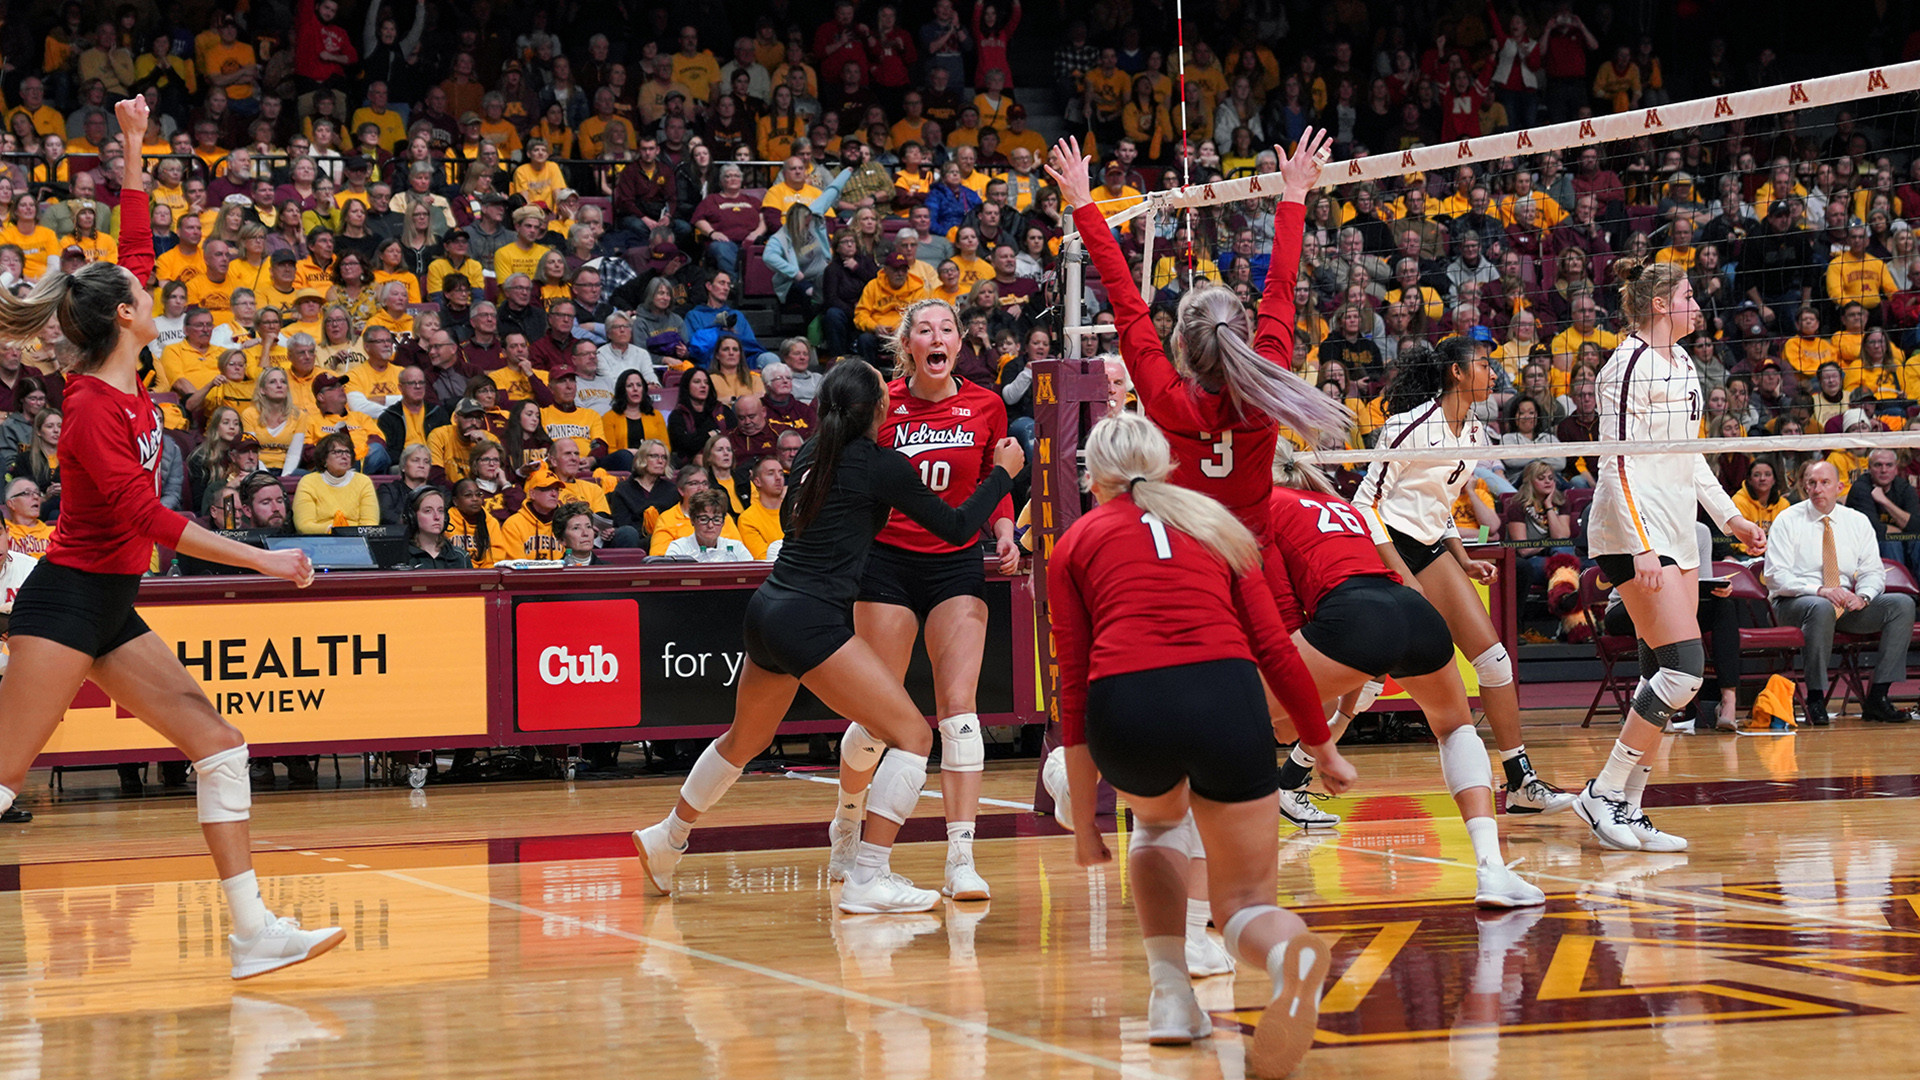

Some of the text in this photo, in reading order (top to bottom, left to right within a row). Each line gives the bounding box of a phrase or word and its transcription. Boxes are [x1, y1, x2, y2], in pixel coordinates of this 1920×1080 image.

[1867, 69, 1890, 93] M
[1453, 96, 1472, 115] N
[1788, 83, 1809, 105] M
[1644, 108, 1663, 129] M
[1714, 96, 1734, 118] M
[1517, 130, 1533, 149] M
[1579, 119, 1596, 139] M
[1401, 150, 1416, 168] M
[1457, 141, 1473, 159] M
[1348, 159, 1362, 176] M
[1203, 184, 1216, 200] M
[1249, 176, 1262, 193] M
[1036, 373, 1056, 405] M
[893, 421, 975, 449] Nebraska
[1200, 429, 1234, 478] 3
[918, 460, 951, 492] 10
[1447, 460, 1466, 485] 8
[1299, 498, 1366, 536] 26
[211, 530, 249, 538] VSPORT
[1140, 511, 1173, 560] 1
[177, 633, 387, 681] HEALTH
[539, 645, 617, 685] Cub
[661, 641, 744, 687] for y
[216, 688, 325, 715] IRVIEW
